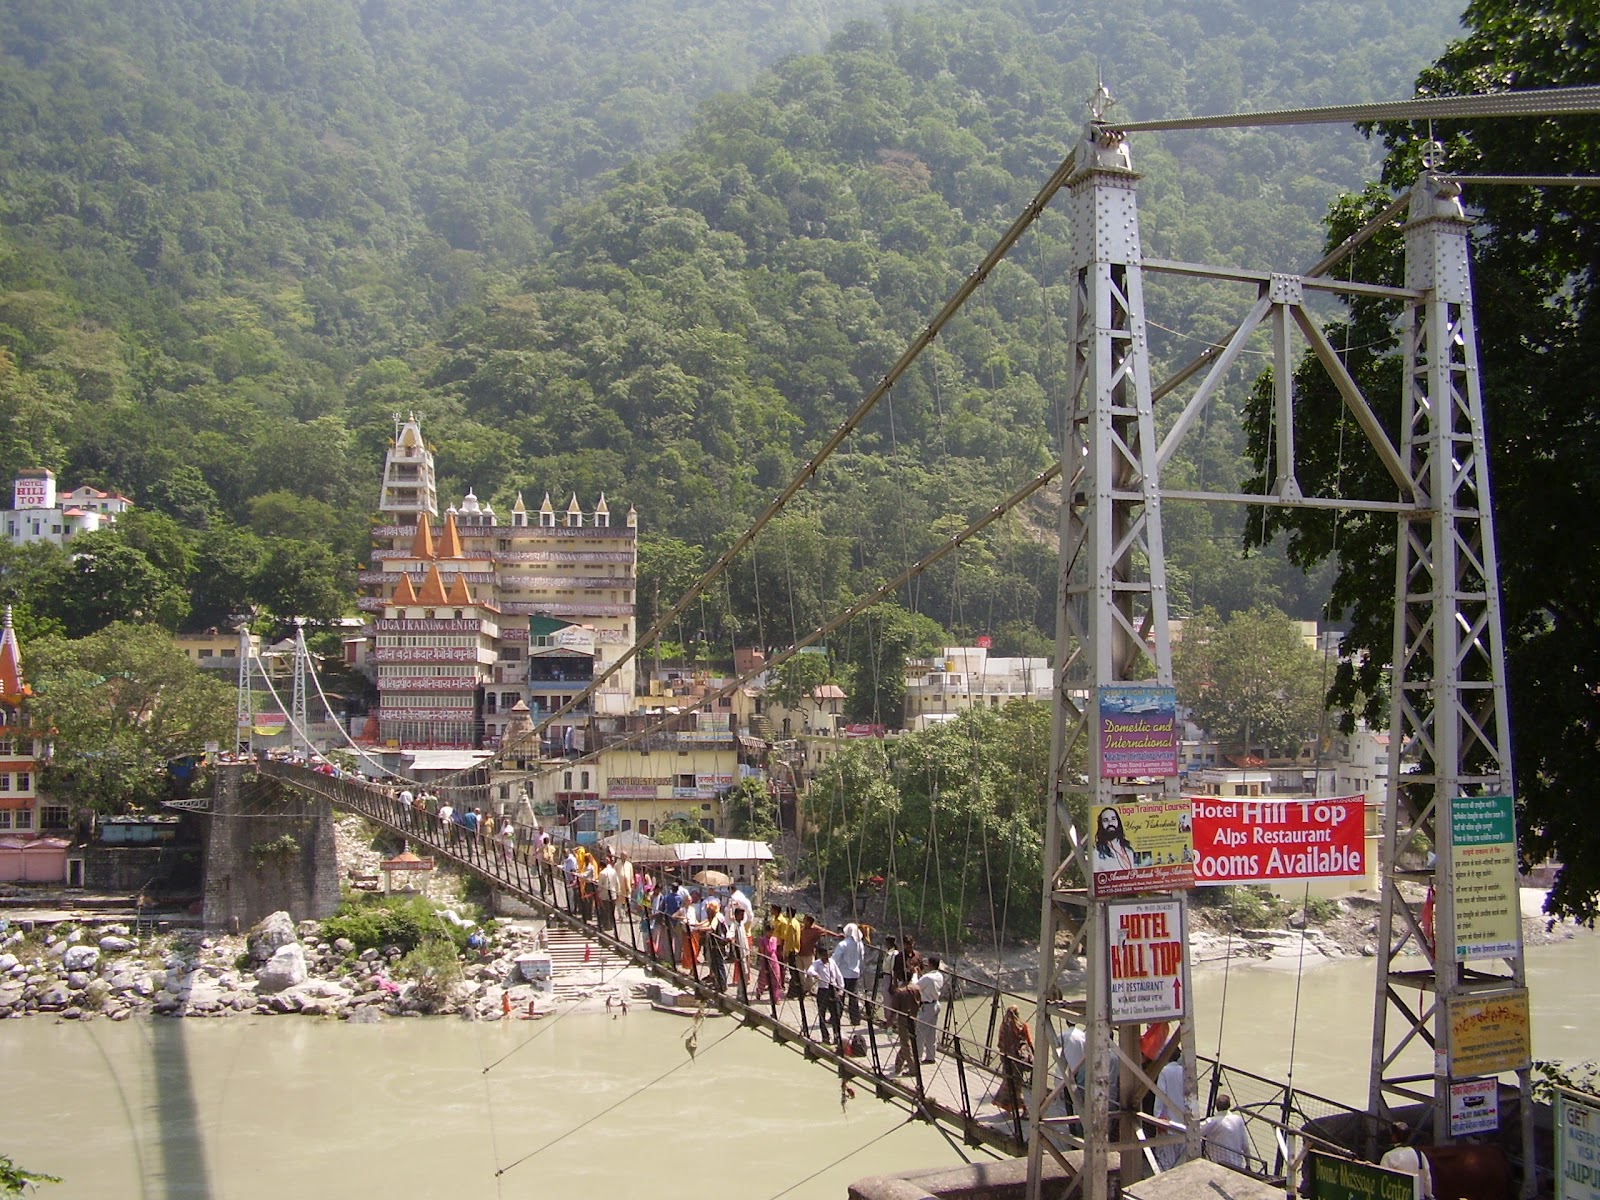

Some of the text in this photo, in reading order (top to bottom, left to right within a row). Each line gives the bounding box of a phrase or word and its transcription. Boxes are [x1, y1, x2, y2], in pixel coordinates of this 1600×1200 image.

[376, 620, 480, 631] YOGA TRAINING CENTRE
[1104, 718, 1173, 732] Domestic and
[1105, 734, 1173, 748] International
[1118, 802, 1190, 816] Yoga Training Courses
[1192, 801, 1346, 826] Hotel Hill Top
[1213, 827, 1331, 848] Alps Restaurant
[1193, 845, 1360, 877] Rooms Available
[1120, 913, 1170, 938] HOTEL
[1111, 942, 1183, 979] HILL TOP
[1126, 981, 1164, 992] RESTAURANT
[1567, 1108, 1588, 1128] GET
[1340, 1164, 1376, 1198] Massage
[1381, 1176, 1412, 1200] Centre
